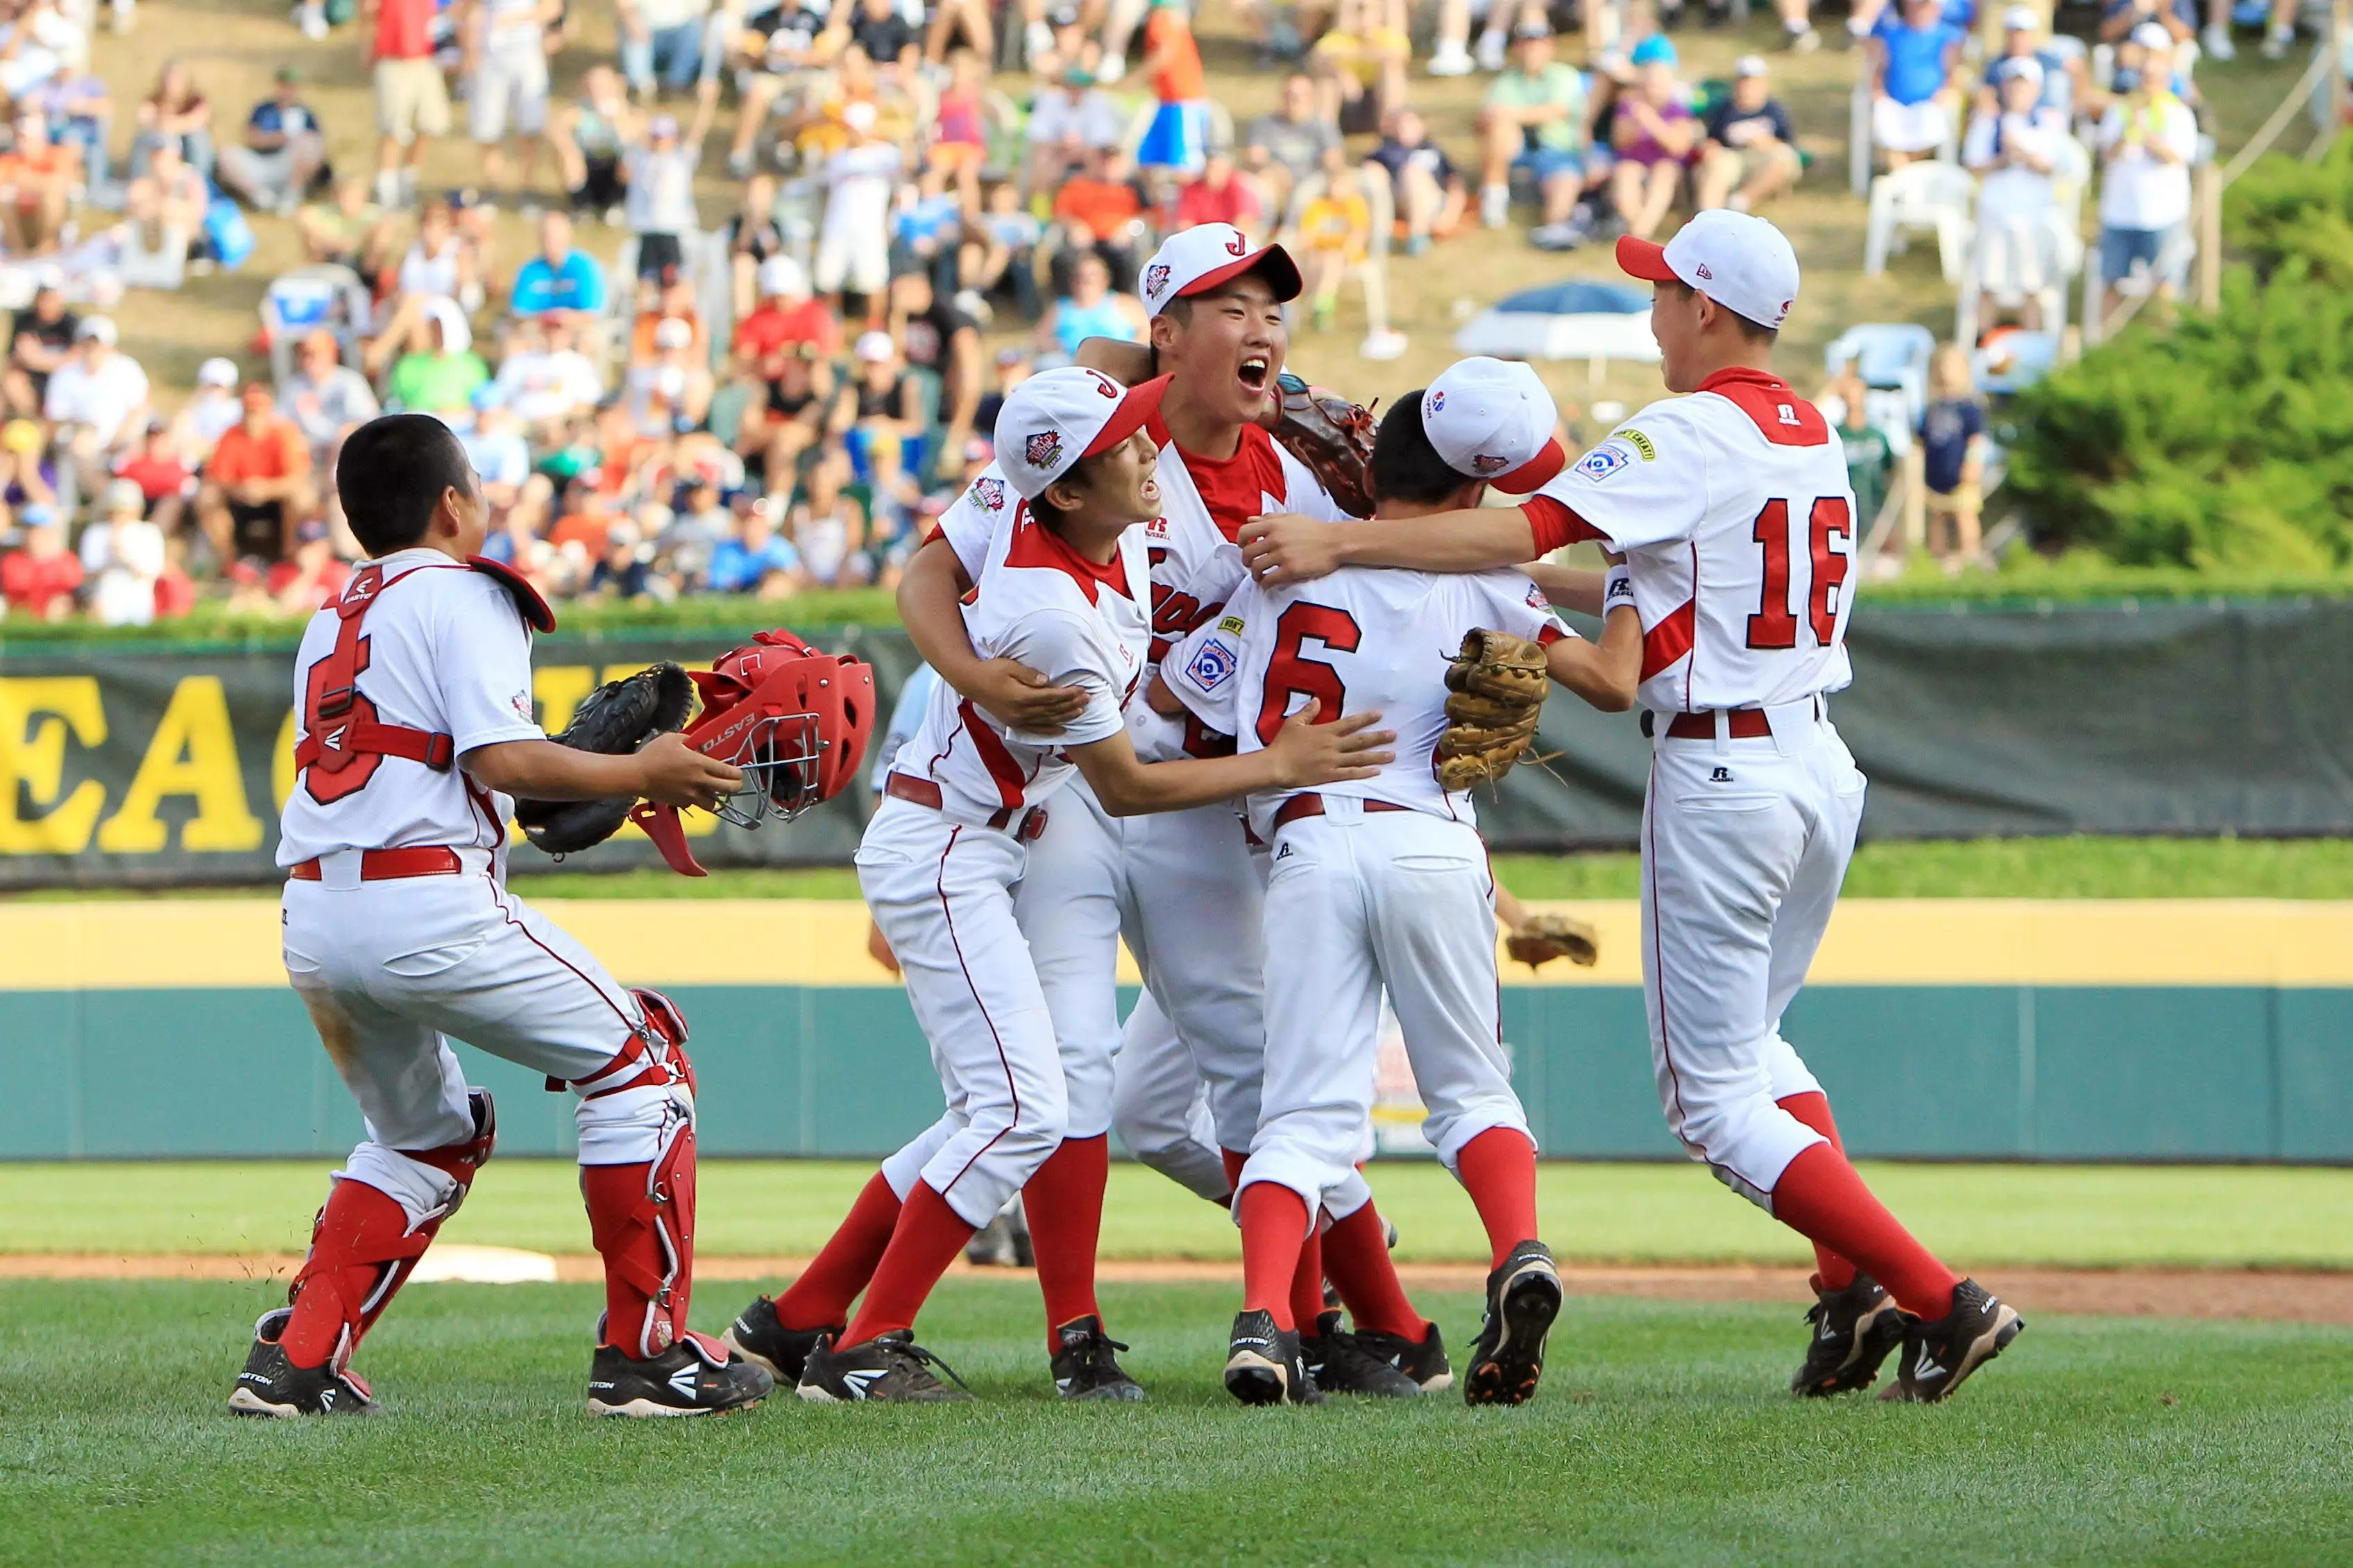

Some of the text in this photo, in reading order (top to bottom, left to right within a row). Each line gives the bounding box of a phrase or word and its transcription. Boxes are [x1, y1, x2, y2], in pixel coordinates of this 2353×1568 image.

[1225, 230, 1246, 256] J
[1086, 369, 1119, 399] J
[1746, 496, 1851, 650] 16
[344, 593, 374, 604] EASTO
[1255, 599, 1362, 747] 6
[702, 713, 756, 753] EASTO
[1232, 1337, 1268, 1347] EASTON
